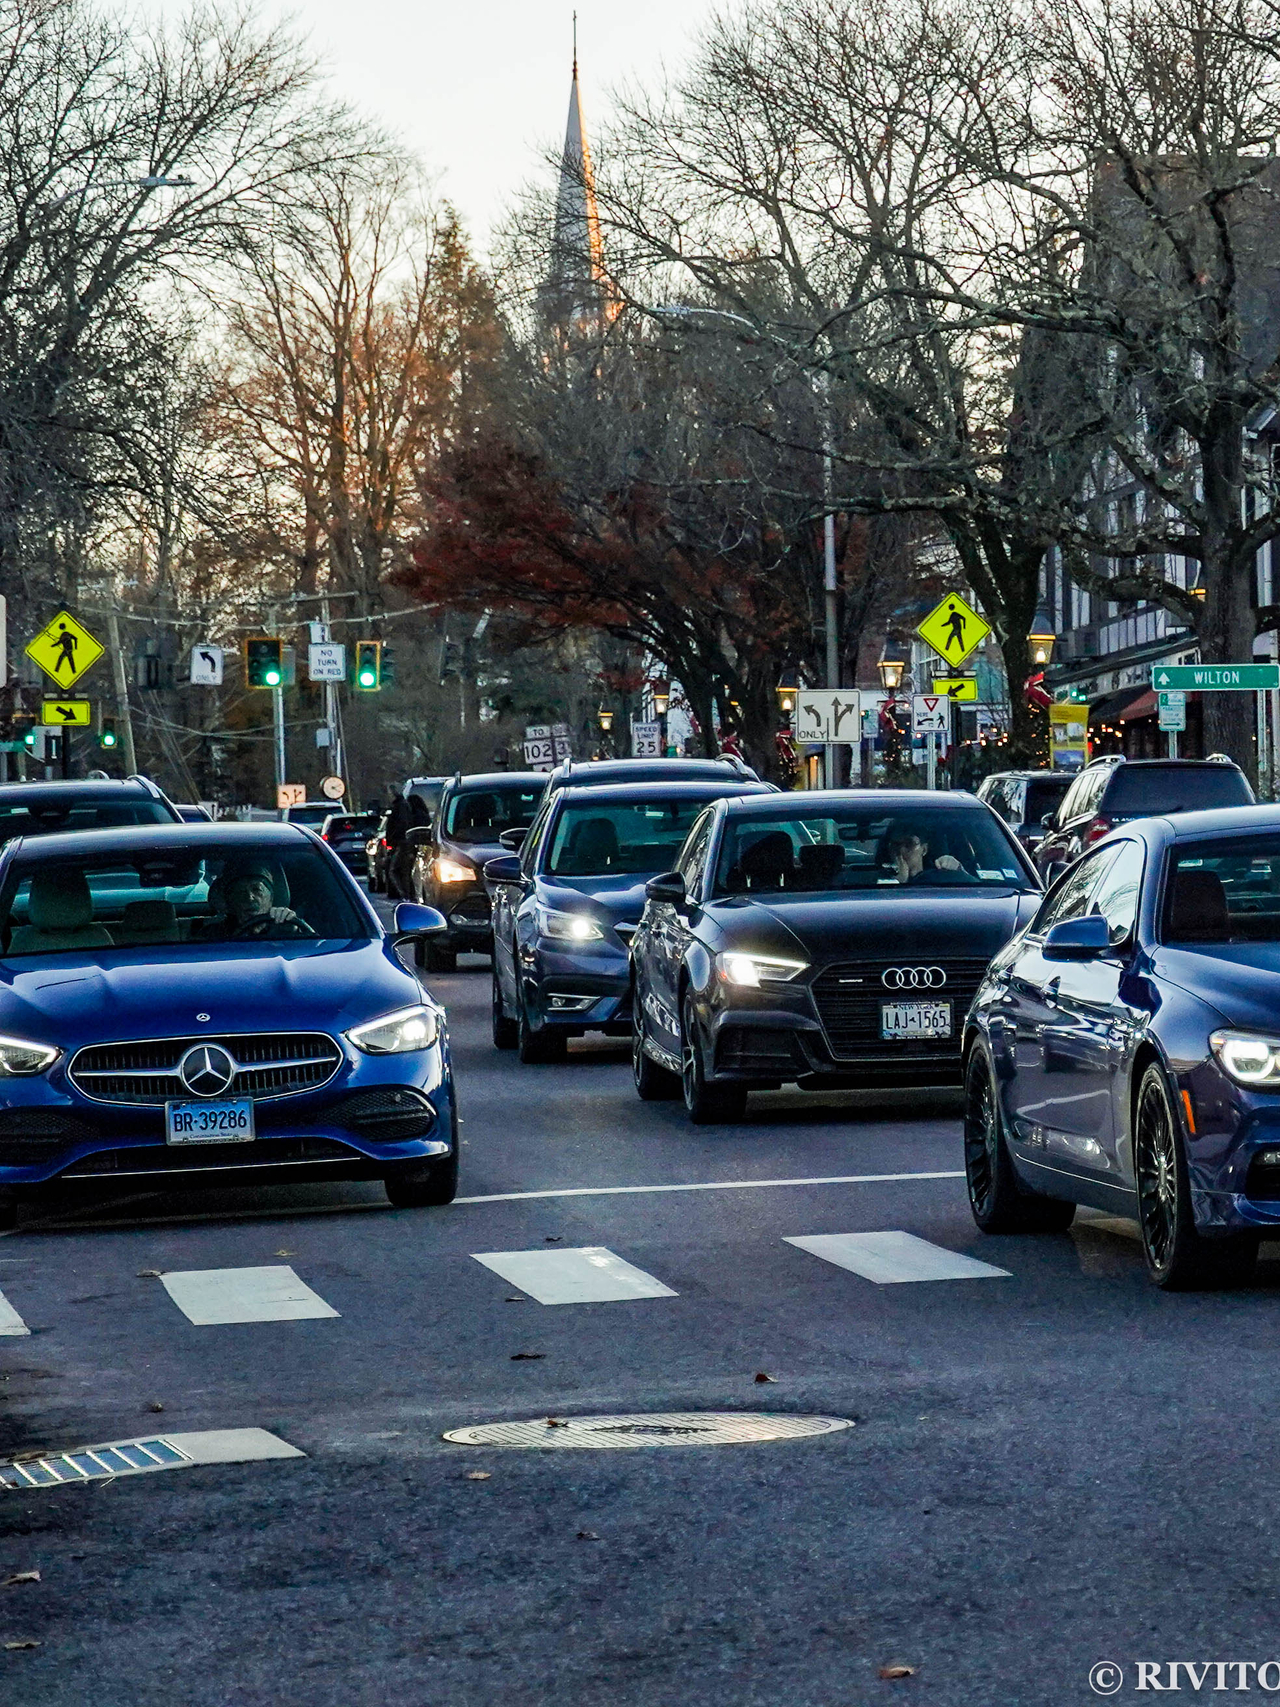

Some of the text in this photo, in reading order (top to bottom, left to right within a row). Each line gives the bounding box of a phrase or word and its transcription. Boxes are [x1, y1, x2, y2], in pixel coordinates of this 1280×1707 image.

[327, 668, 342, 676] RED
[1194, 671, 1240, 684] WILTON
[799, 730, 827, 739] ONLY
[525, 743, 553, 759] 102
[636, 742, 656, 753] 25
